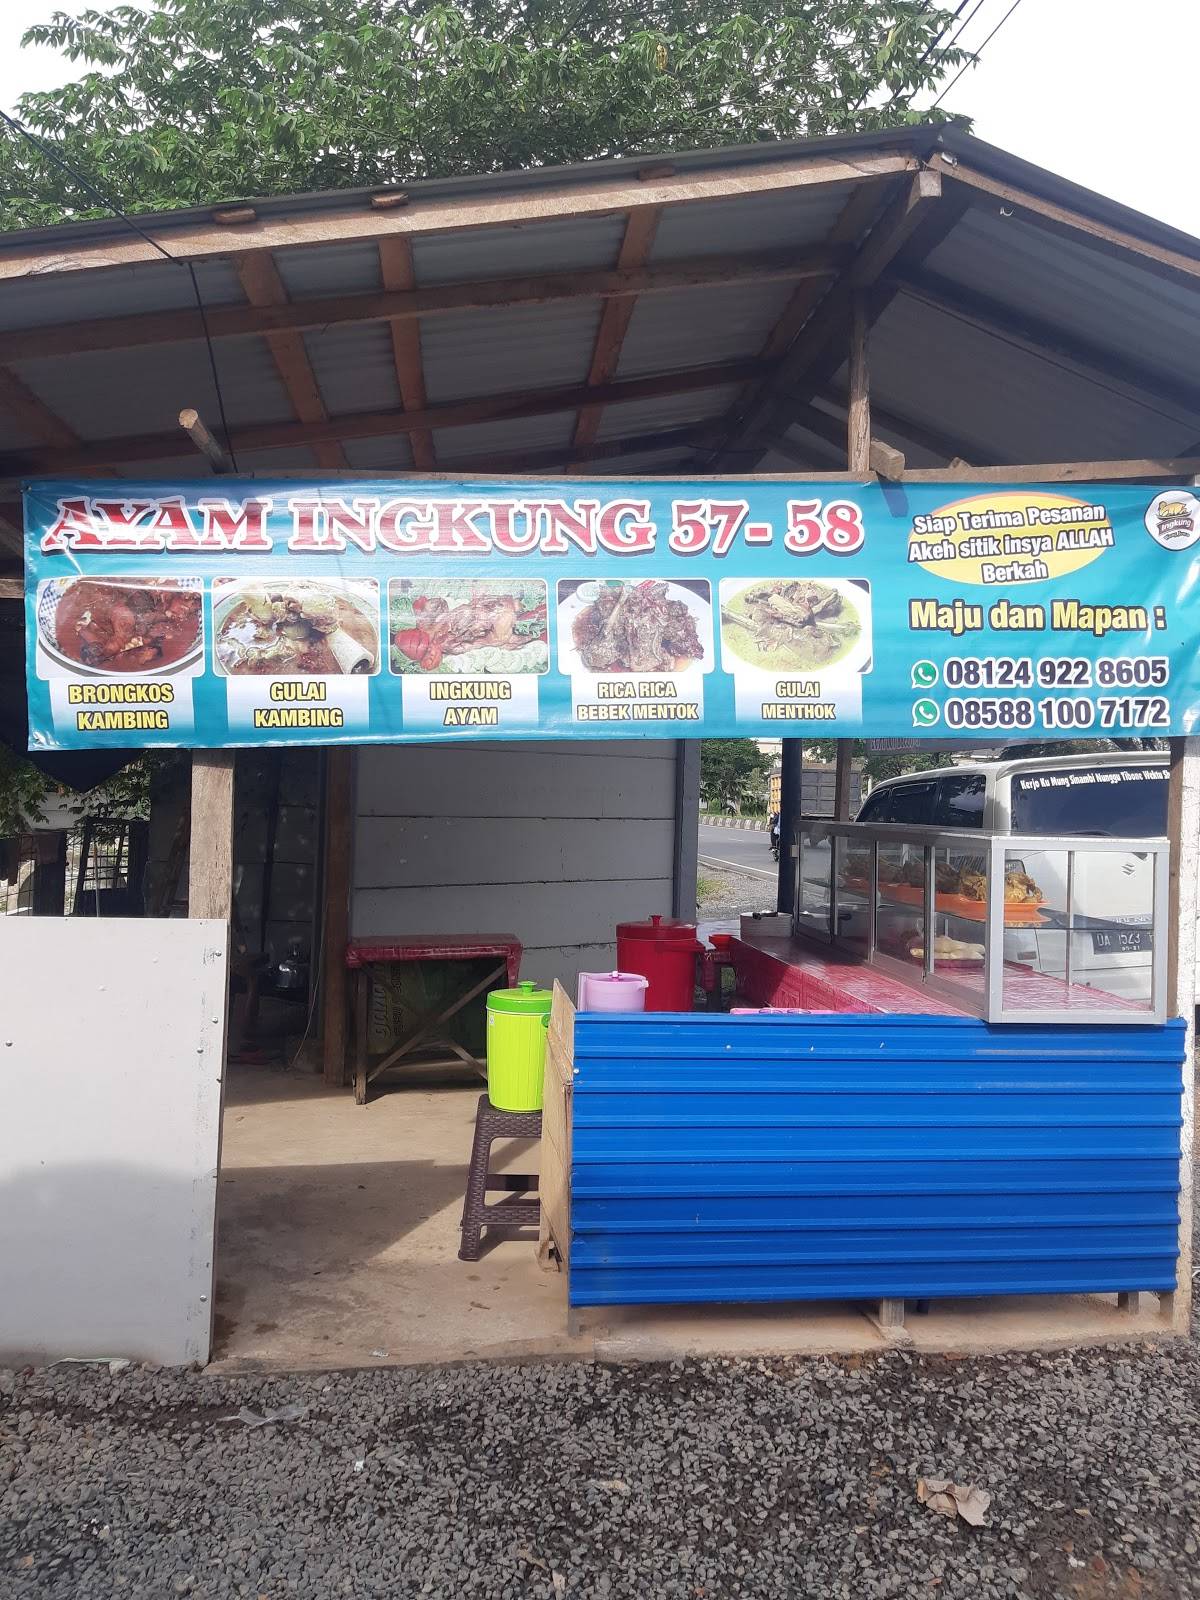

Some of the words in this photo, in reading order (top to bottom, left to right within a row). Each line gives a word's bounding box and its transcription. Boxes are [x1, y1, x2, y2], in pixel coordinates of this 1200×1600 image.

[41, 496, 273, 551] AYAM
[289, 498, 656, 553] INGKUNG
[785, 498, 865, 554] 58
[913, 515, 956, 535] Siap
[959, 510, 1023, 530] Terima
[1025, 505, 1106, 526] Pesanan
[907, 542, 956, 563] Akeh
[959, 537, 1003, 559] sitik
[1004, 534, 1052, 556] insya
[1056, 528, 1115, 550] ALLAH
[981, 560, 1048, 584] Berkah
[909, 599, 983, 636] Maju
[989, 599, 1046, 630] dan
[1051, 599, 1148, 637] Mapan
[945, 659, 1031, 686] 08124
[1039, 659, 1090, 686] 922
[1099, 658, 1168, 685] 8605
[69, 683, 174, 705] BRONGKOS
[270, 682, 326, 701] GULAI
[429, 681, 511, 700] INGKUNG
[598, 681, 636, 699] RICA
[638, 681, 677, 699] RICA
[775, 680, 820, 698] GULAI
[77, 710, 169, 731] KAMBING
[254, 708, 343, 729] KAMBING
[443, 706, 499, 726] AYAM
[577, 704, 631, 721] BEBEK
[633, 703, 699, 720] MENTOK
[762, 703, 836, 720] MENTHOK
[947, 700, 1033, 726] 08588
[1041, 699, 1092, 726] 100
[1100, 698, 1168, 725] 7172
